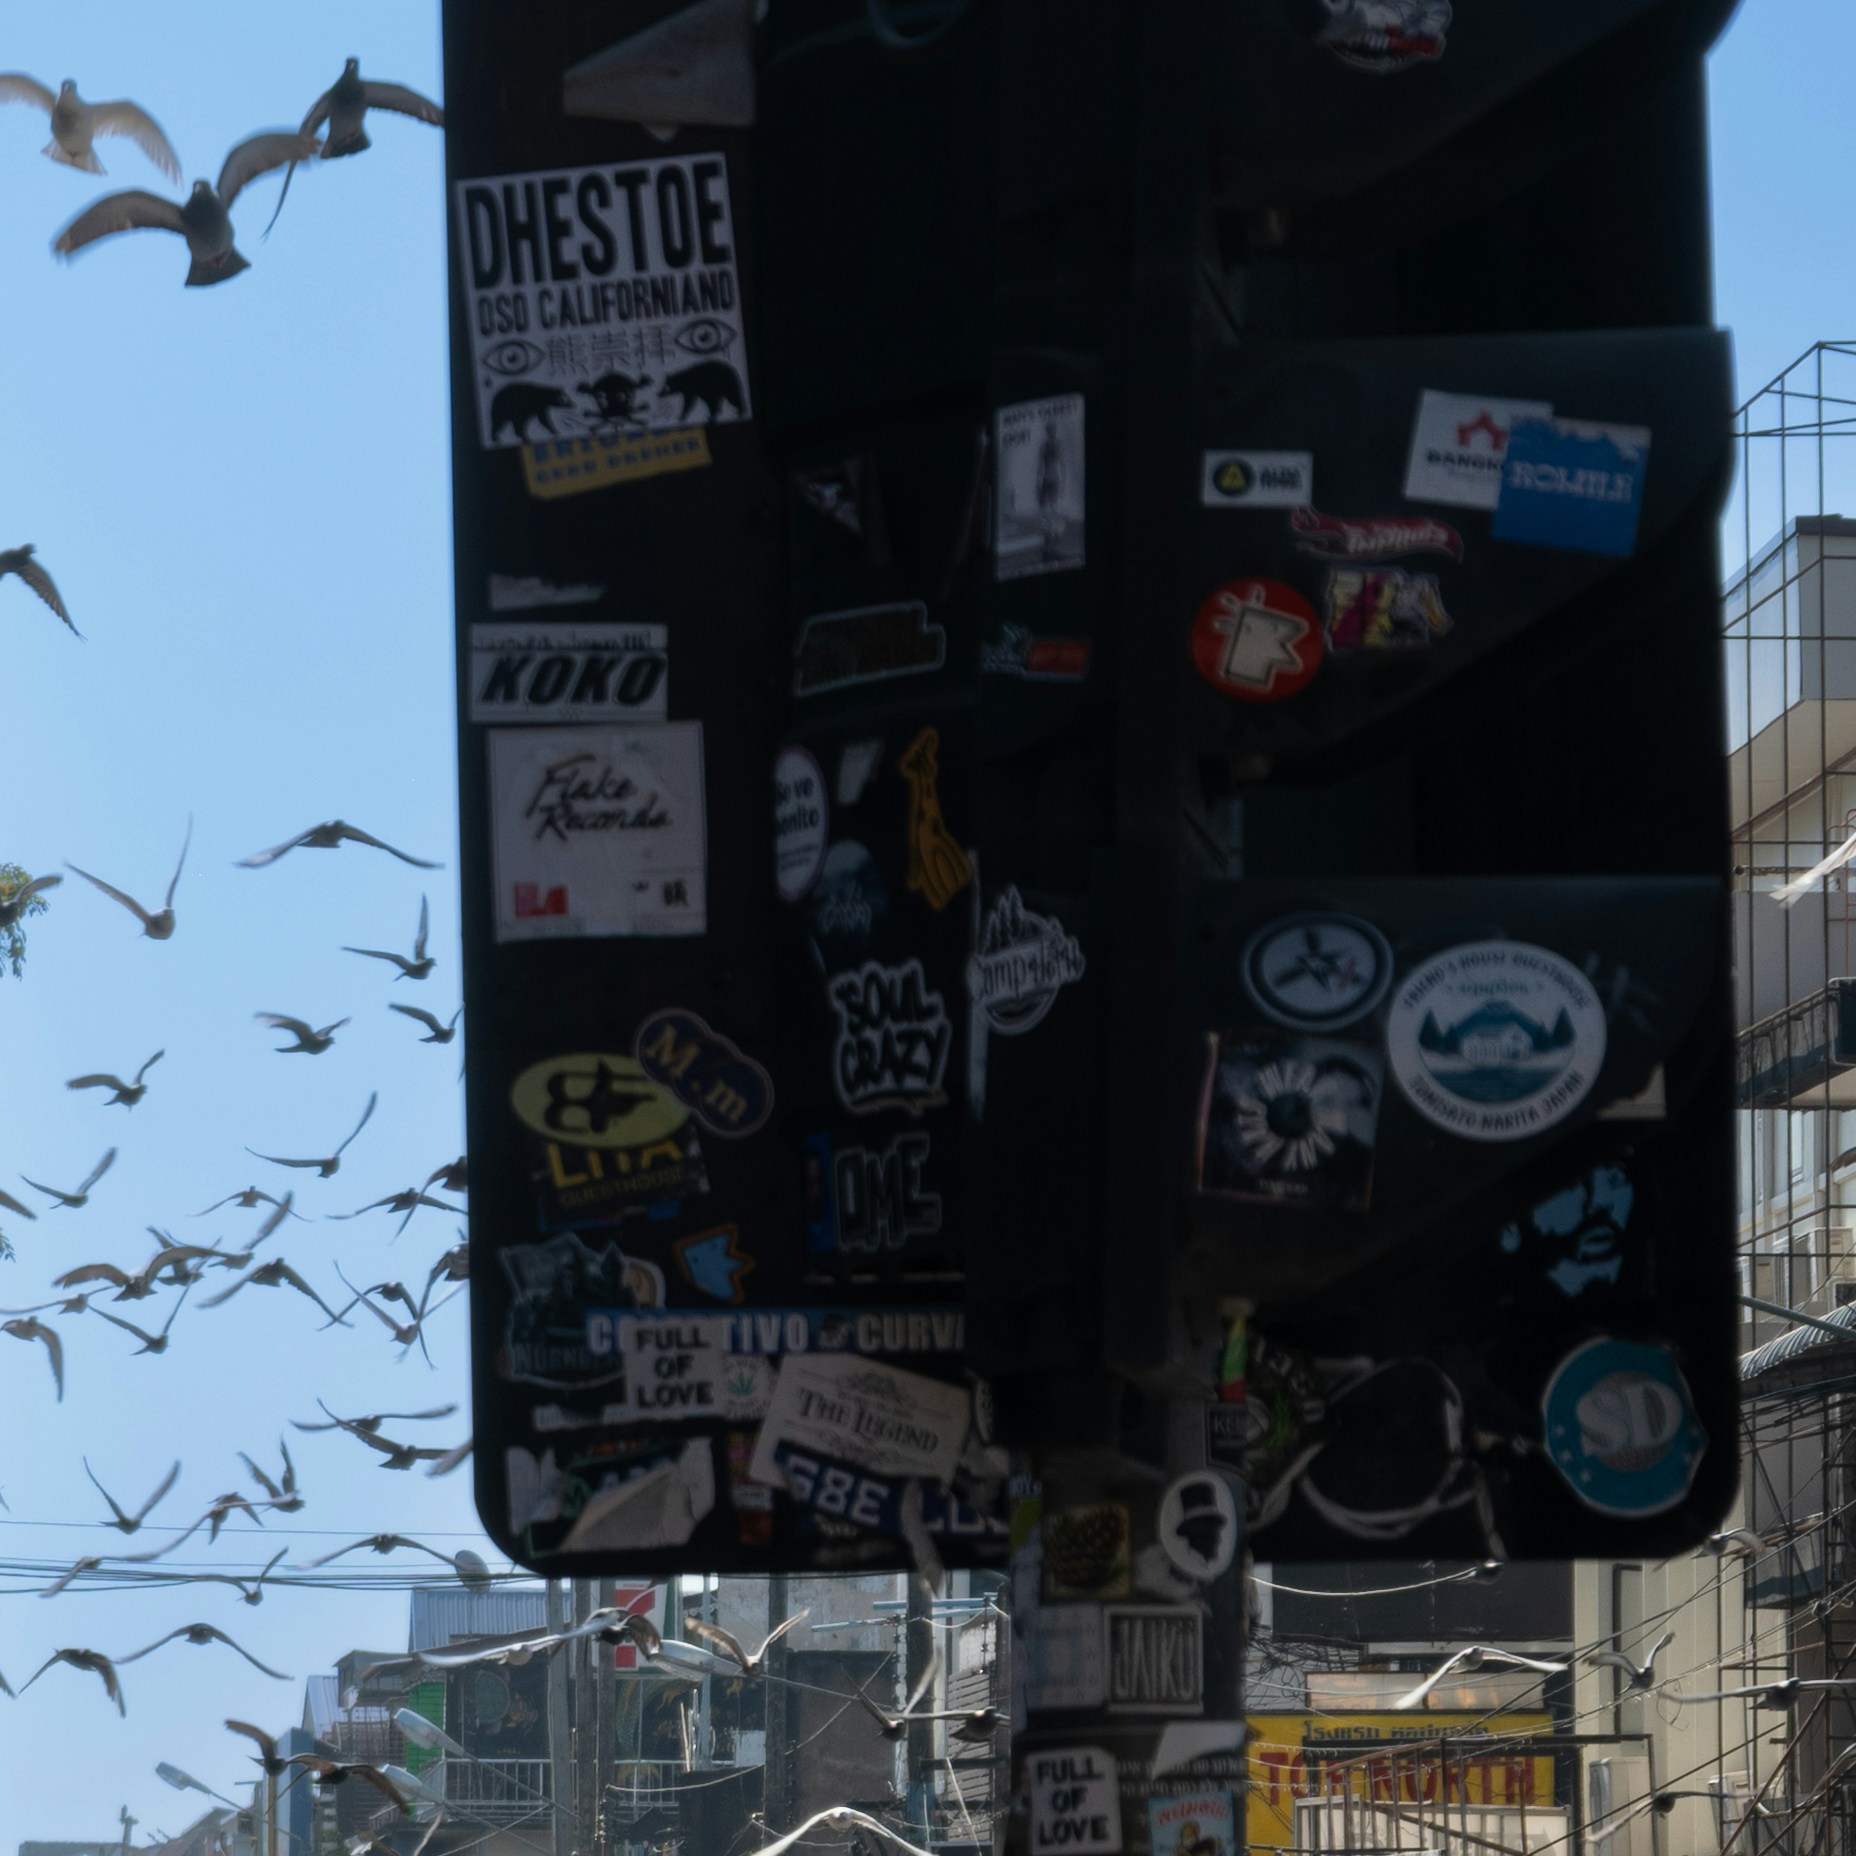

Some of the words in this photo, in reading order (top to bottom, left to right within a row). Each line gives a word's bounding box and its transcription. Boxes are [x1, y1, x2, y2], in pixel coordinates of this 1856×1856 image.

[465, 161, 730, 289] DHESTOE
[477, 291, 529, 336] OSO
[538, 269, 734, 330] CALIFORNIANO
[482, 655, 666, 706] KOKO
[637, 1327, 710, 1349] FULL
[655, 1355, 692, 1378] OF
[638, 1382, 714, 1408] LOVE
[853, 1408, 940, 1452] LEGEND
[1036, 1757, 1104, 1785] FULL
[1051, 1787, 1089, 1812] OF
[1038, 1815, 1110, 1844] LOVE
